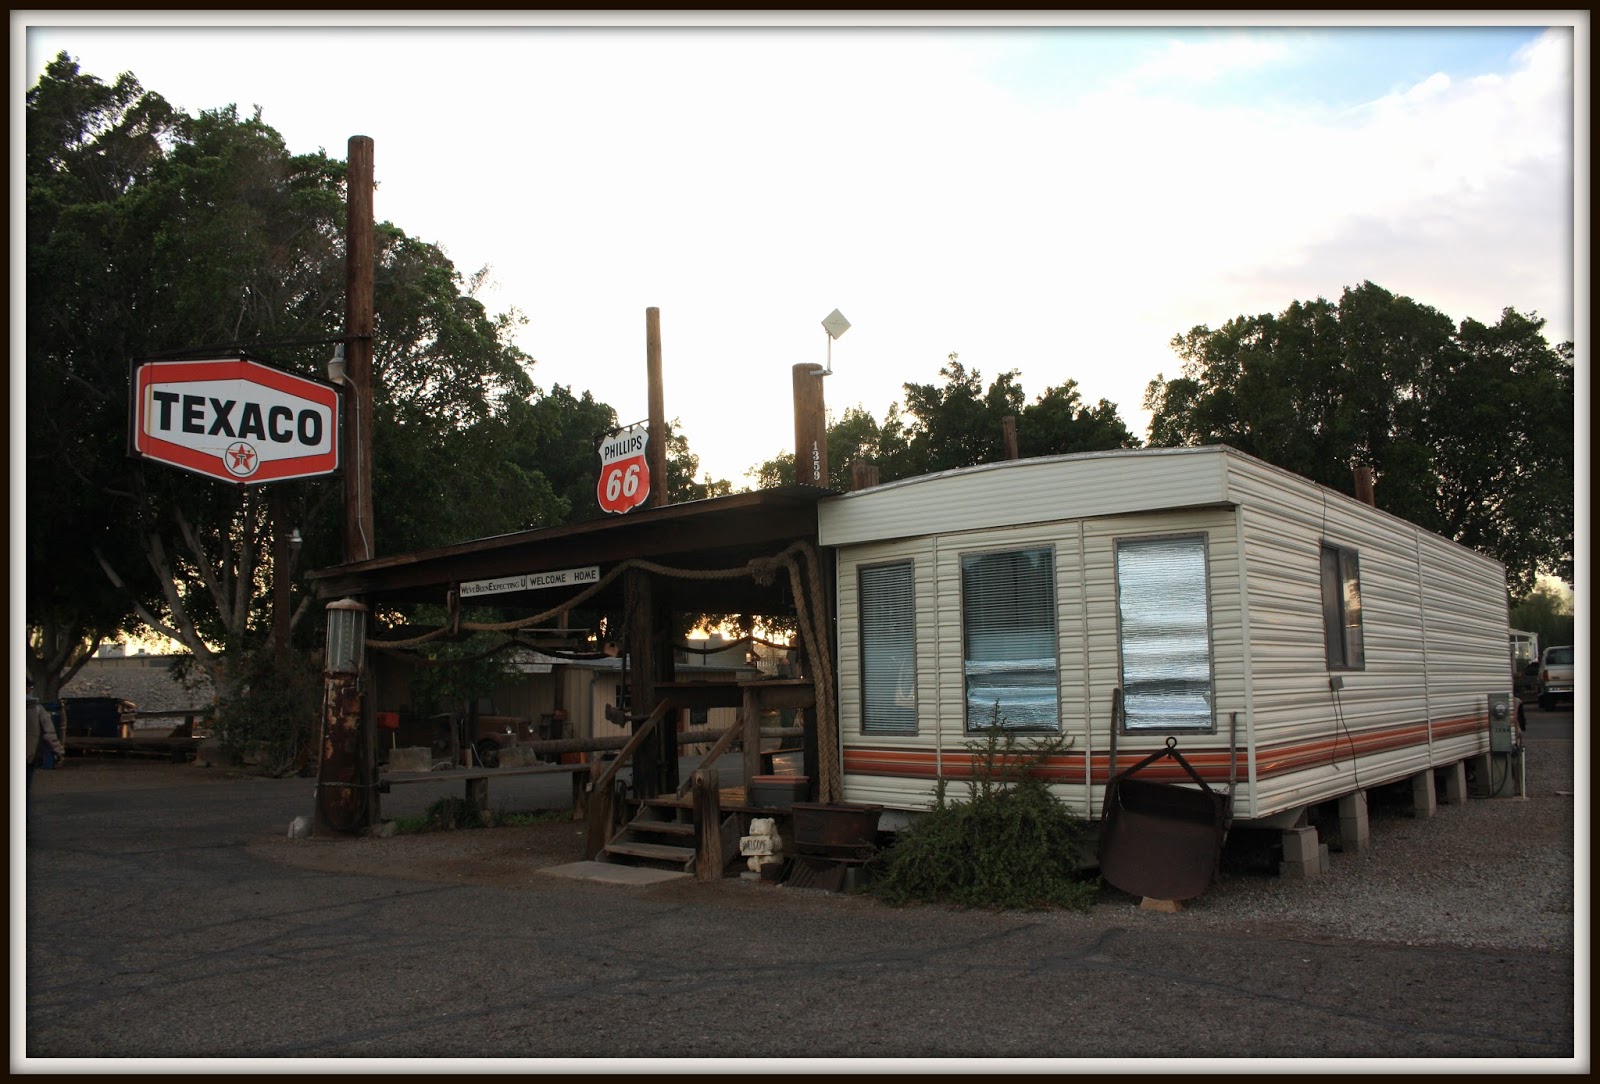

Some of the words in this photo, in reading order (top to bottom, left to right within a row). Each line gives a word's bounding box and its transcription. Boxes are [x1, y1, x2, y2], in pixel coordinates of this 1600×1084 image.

[153, 390, 323, 446] TEXACO
[237, 454, 246, 465] T
[604, 435, 642, 460] PHILLIPS
[812, 441, 820, 480] 1359
[606, 464, 640, 501] 66
[520, 578, 526, 588] U
[530, 573, 566, 586] WELCOME
[574, 569, 596, 581] HOME
